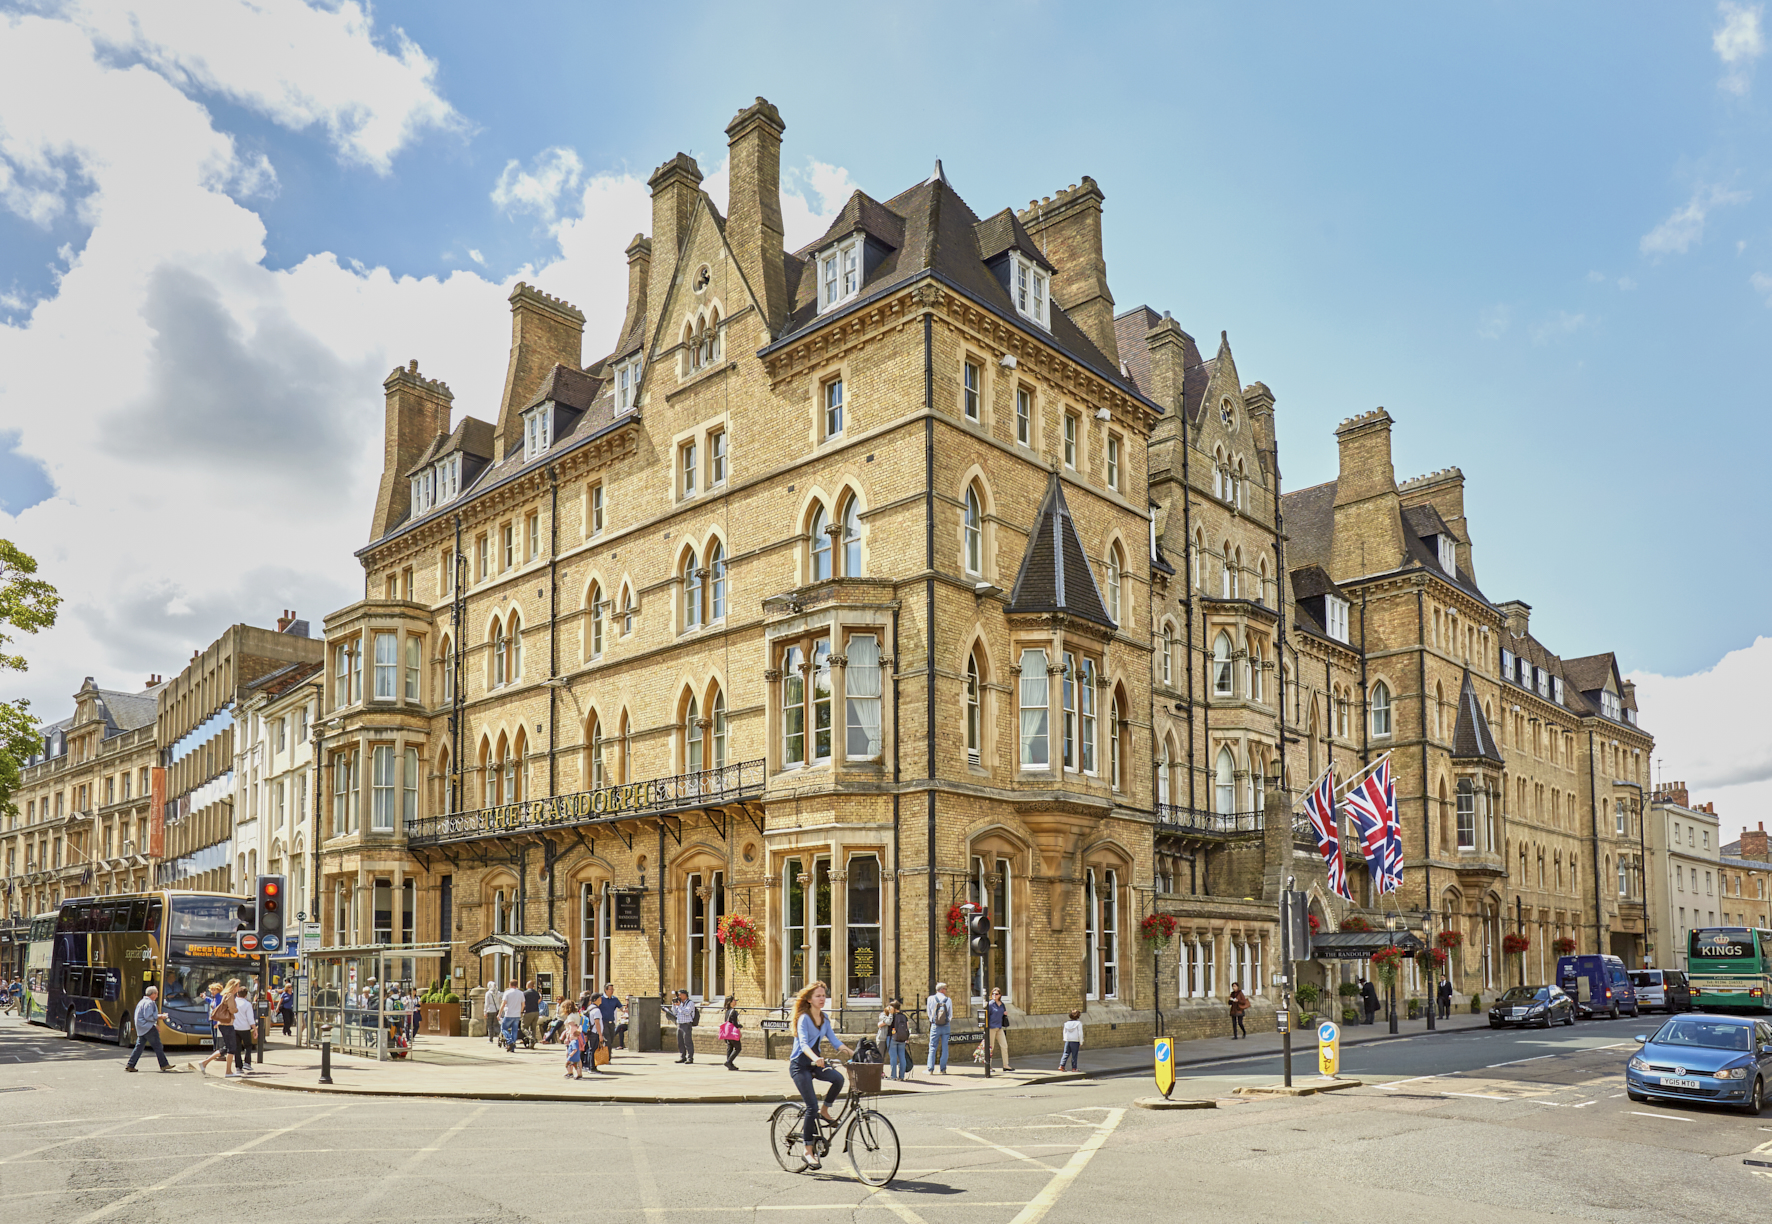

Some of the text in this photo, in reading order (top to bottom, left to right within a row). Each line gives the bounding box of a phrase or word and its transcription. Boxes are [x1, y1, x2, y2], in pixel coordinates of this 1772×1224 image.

[481, 783, 651, 831] THE RANDOLPH
[142, 947, 152, 961] gold
[188, 944, 226, 953] Bicester
[1702, 945, 1743, 956] KINGS
[1664, 1078, 1680, 1086] YG15
